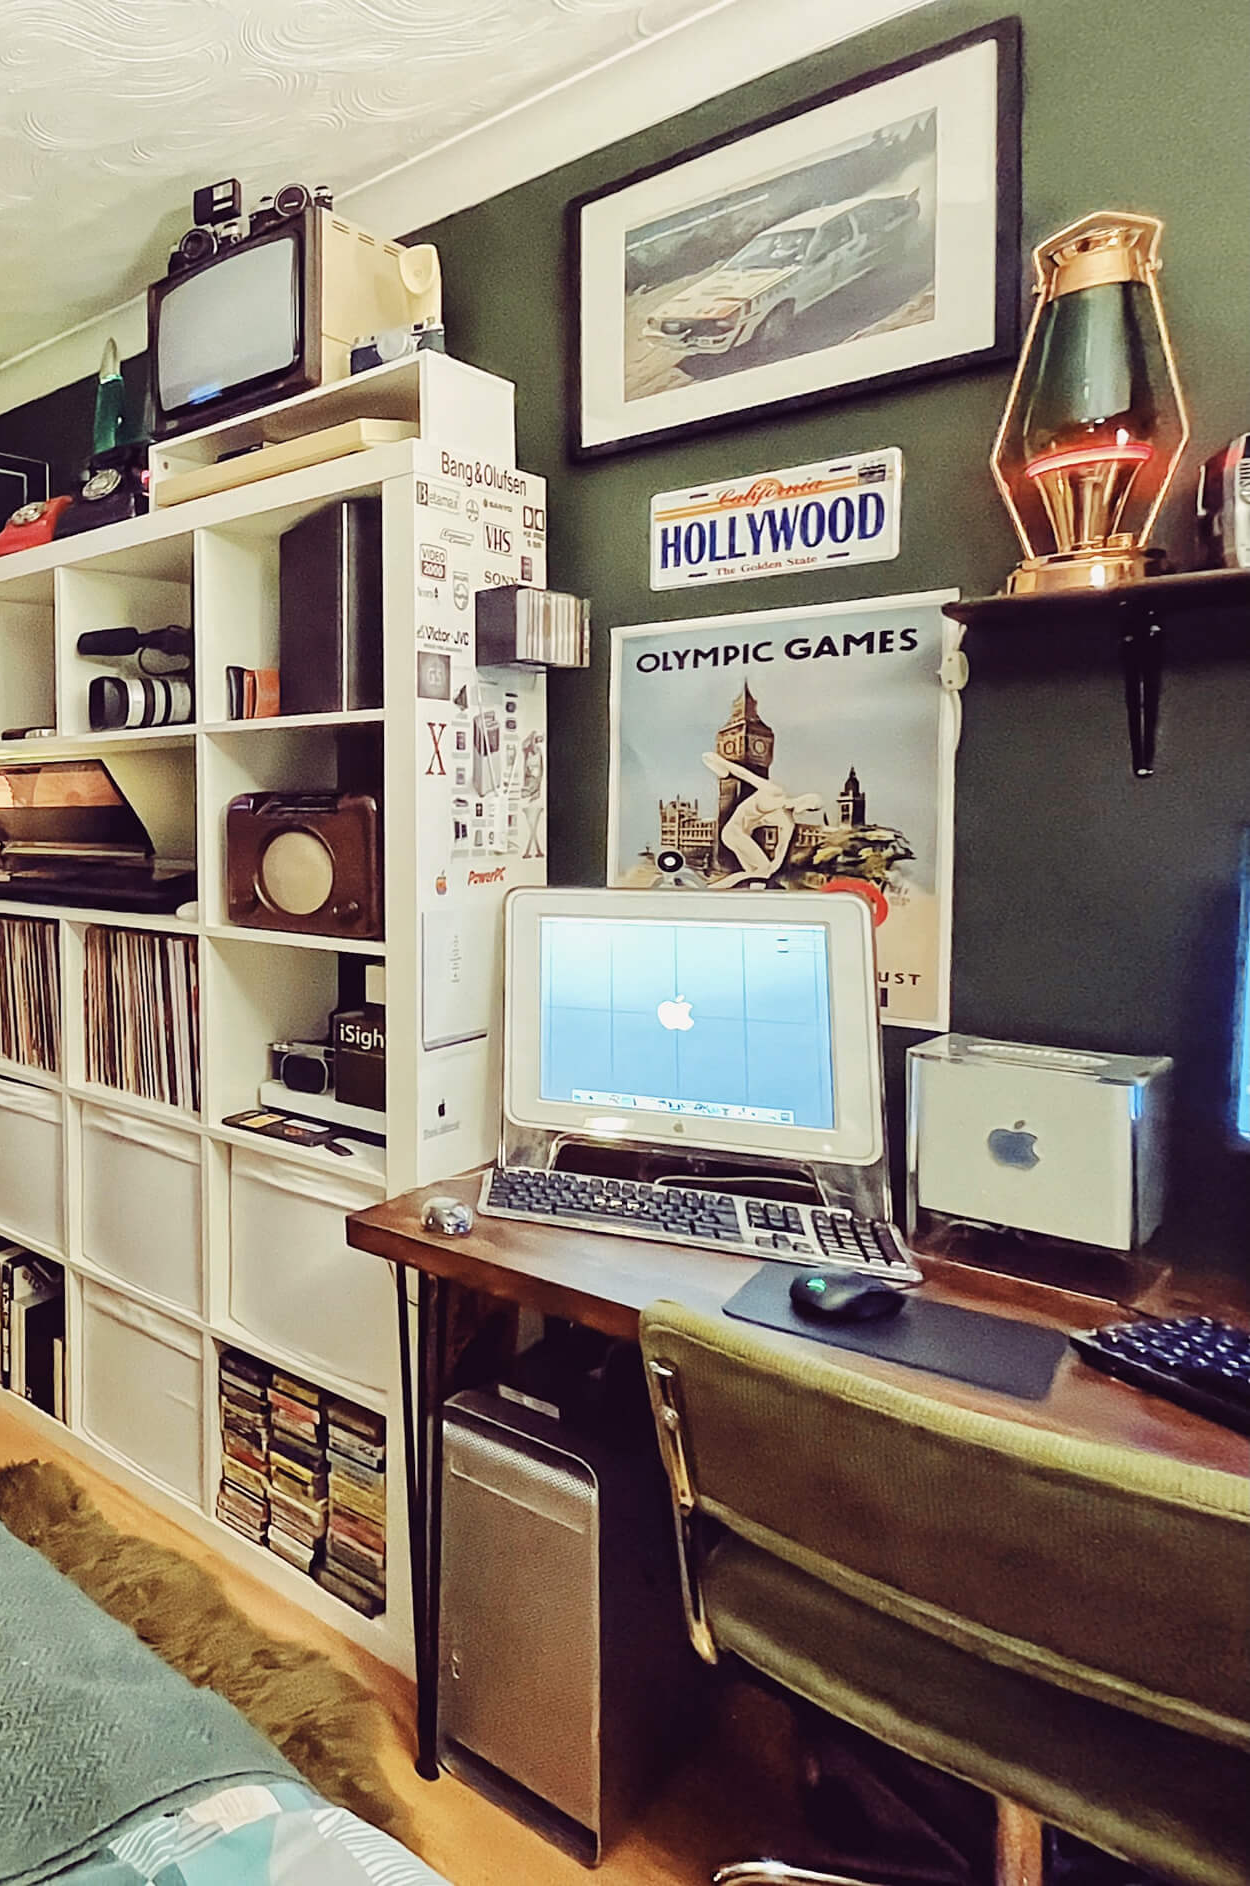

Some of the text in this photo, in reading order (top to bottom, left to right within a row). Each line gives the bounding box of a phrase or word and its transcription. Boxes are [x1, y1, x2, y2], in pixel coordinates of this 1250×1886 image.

[716, 477, 823, 507] California
[486, 525, 511, 553] VHS
[661, 492, 885, 569] HOLLYWOOD
[421, 548, 445, 563] VIDEO
[716, 556, 818, 576] The Golden State
[423, 562, 444, 577] 2000
[485, 570, 518, 586] SONY
[454, 630, 469, 645] JVC
[636, 628, 919, 673] OLYMPIC GAMES
[425, 722, 447, 775] X
[467, 866, 506, 886] PowerPC
[340, 1024, 386, 1050] iSigh
